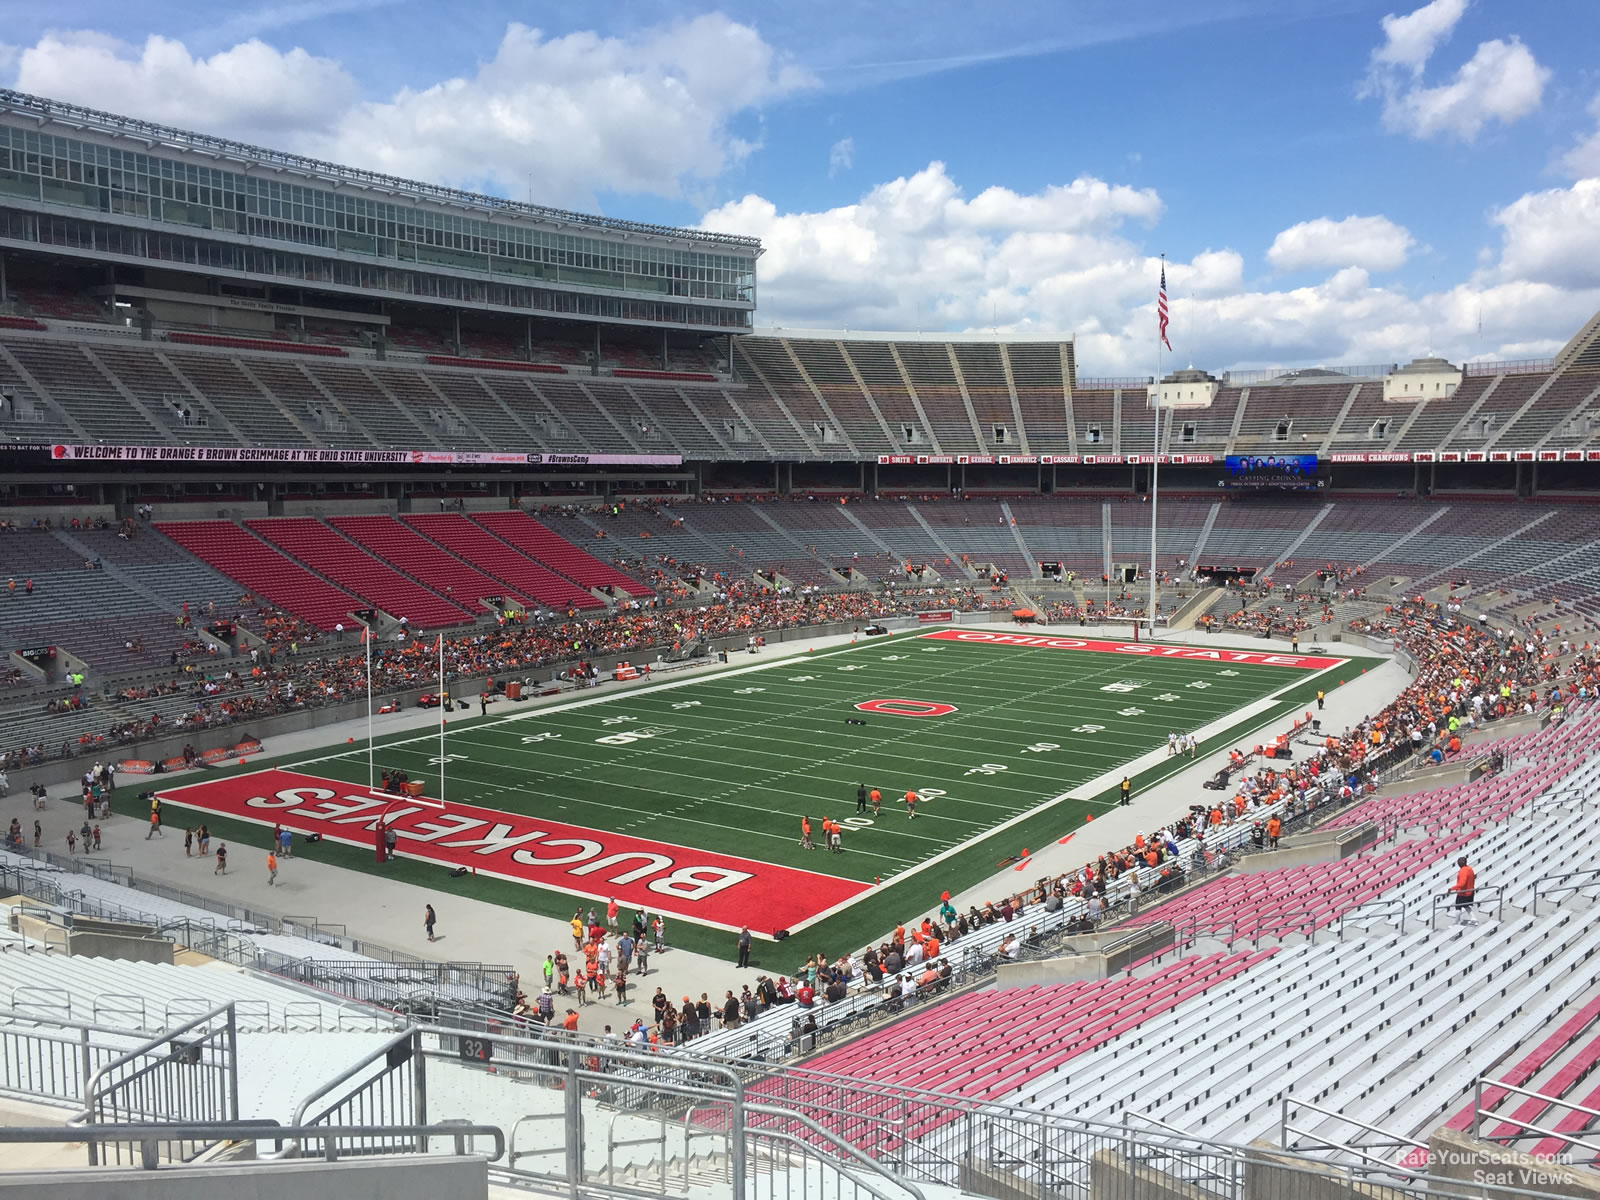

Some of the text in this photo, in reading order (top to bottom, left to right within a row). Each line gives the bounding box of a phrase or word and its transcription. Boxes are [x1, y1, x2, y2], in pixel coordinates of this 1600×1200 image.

[75, 446, 122, 458] WELCOME
[126, 447, 137, 458] TO
[141, 447, 157, 459] THE
[160, 448, 195, 459] ORANGE
[198, 448, 204, 459] &
[206, 449, 238, 460] BROWN
[240, 449, 289, 460] SCRIMMAGE
[291, 450, 301, 460] AT
[303, 450, 318, 460] THE
[320, 451, 338, 460] OHIO
[340, 451, 362, 461] STATE
[364, 452, 407, 461] UNIVERSITY
[548, 454, 589, 464] #BrownsCamp
[1332, 454, 1366, 462] NATIONAL
[1368, 453, 1409, 461] CHAMPIONS
[956, 633, 1306, 665] OHIO STATE
[1071, 724, 1106, 734] 50
[1027, 742, 1060, 752] 40
[969, 763, 1008, 775] 30
[246, 787, 757, 900] BUCKEYES
[465, 1040, 484, 1058] 32
